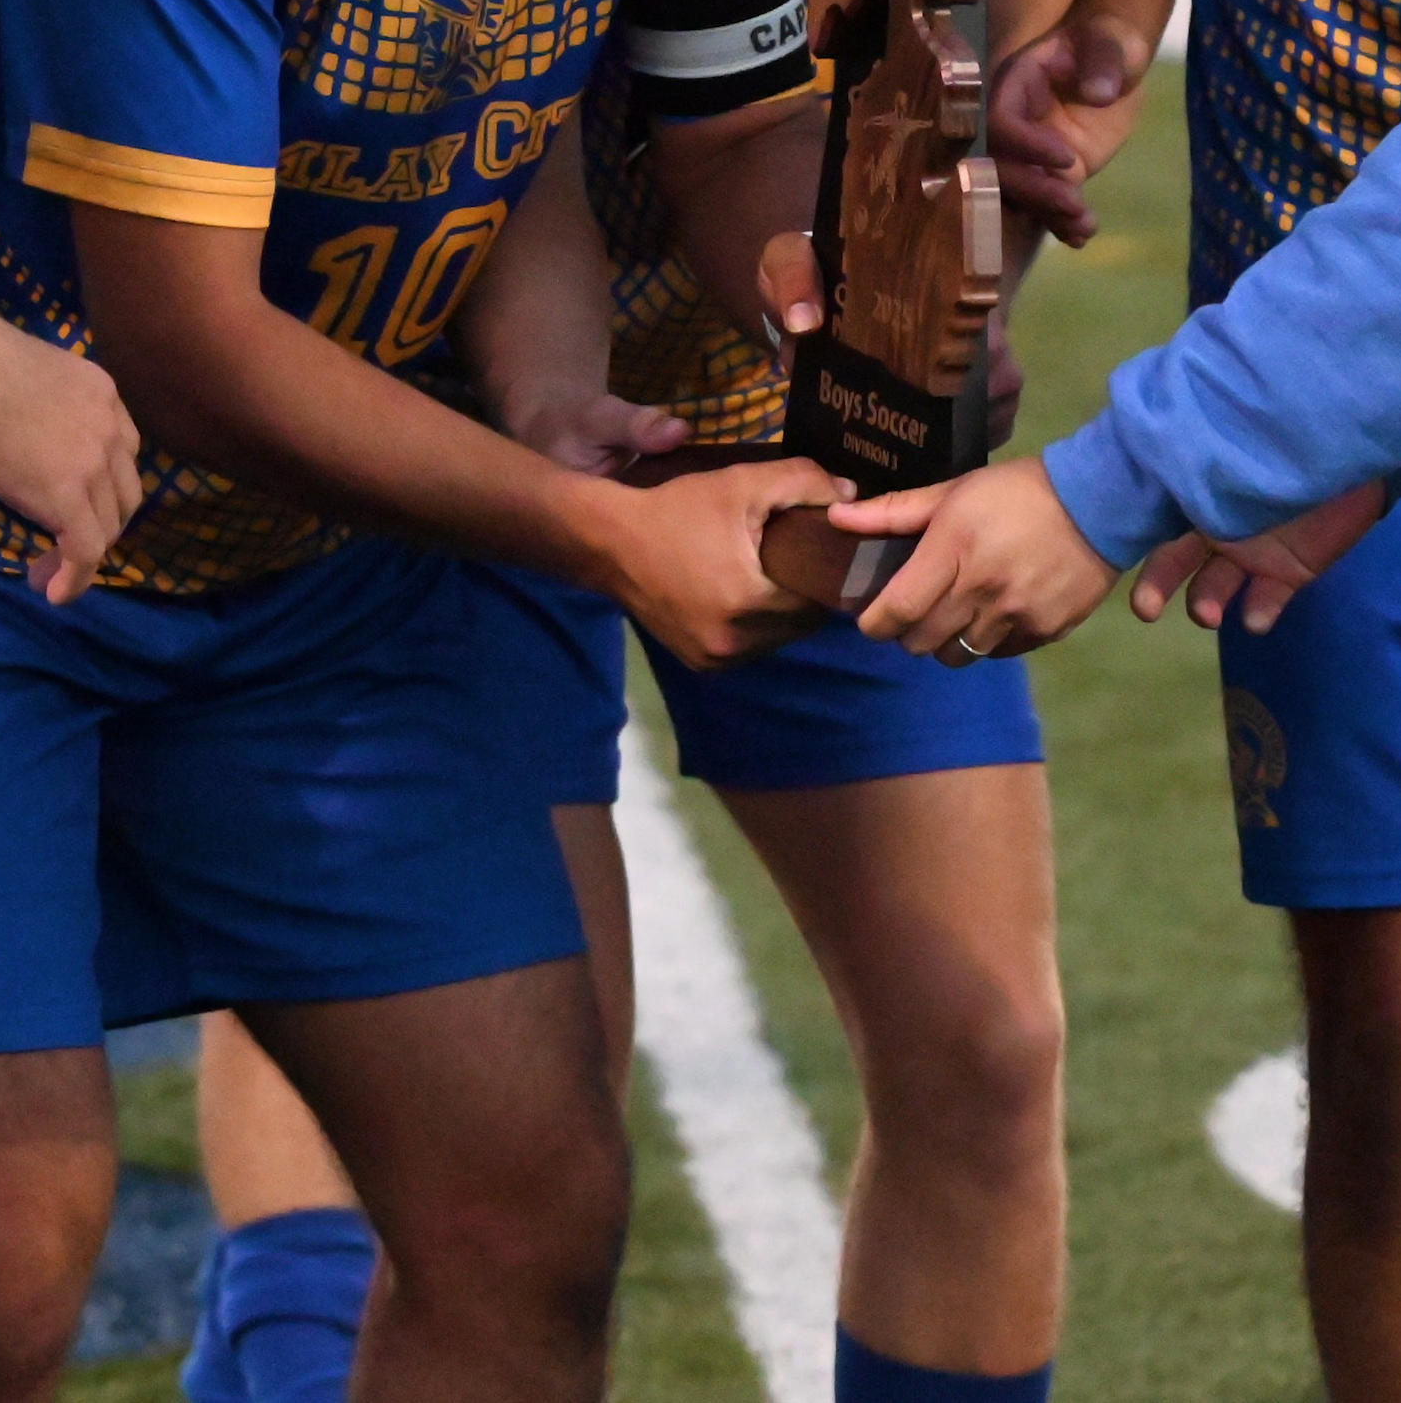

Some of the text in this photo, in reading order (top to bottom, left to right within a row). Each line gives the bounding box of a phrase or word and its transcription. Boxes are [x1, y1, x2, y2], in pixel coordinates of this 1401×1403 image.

[308, 198, 508, 366] 10
[819, 369, 929, 448] Boys Soccer
[843, 431, 890, 467] DIVISION
